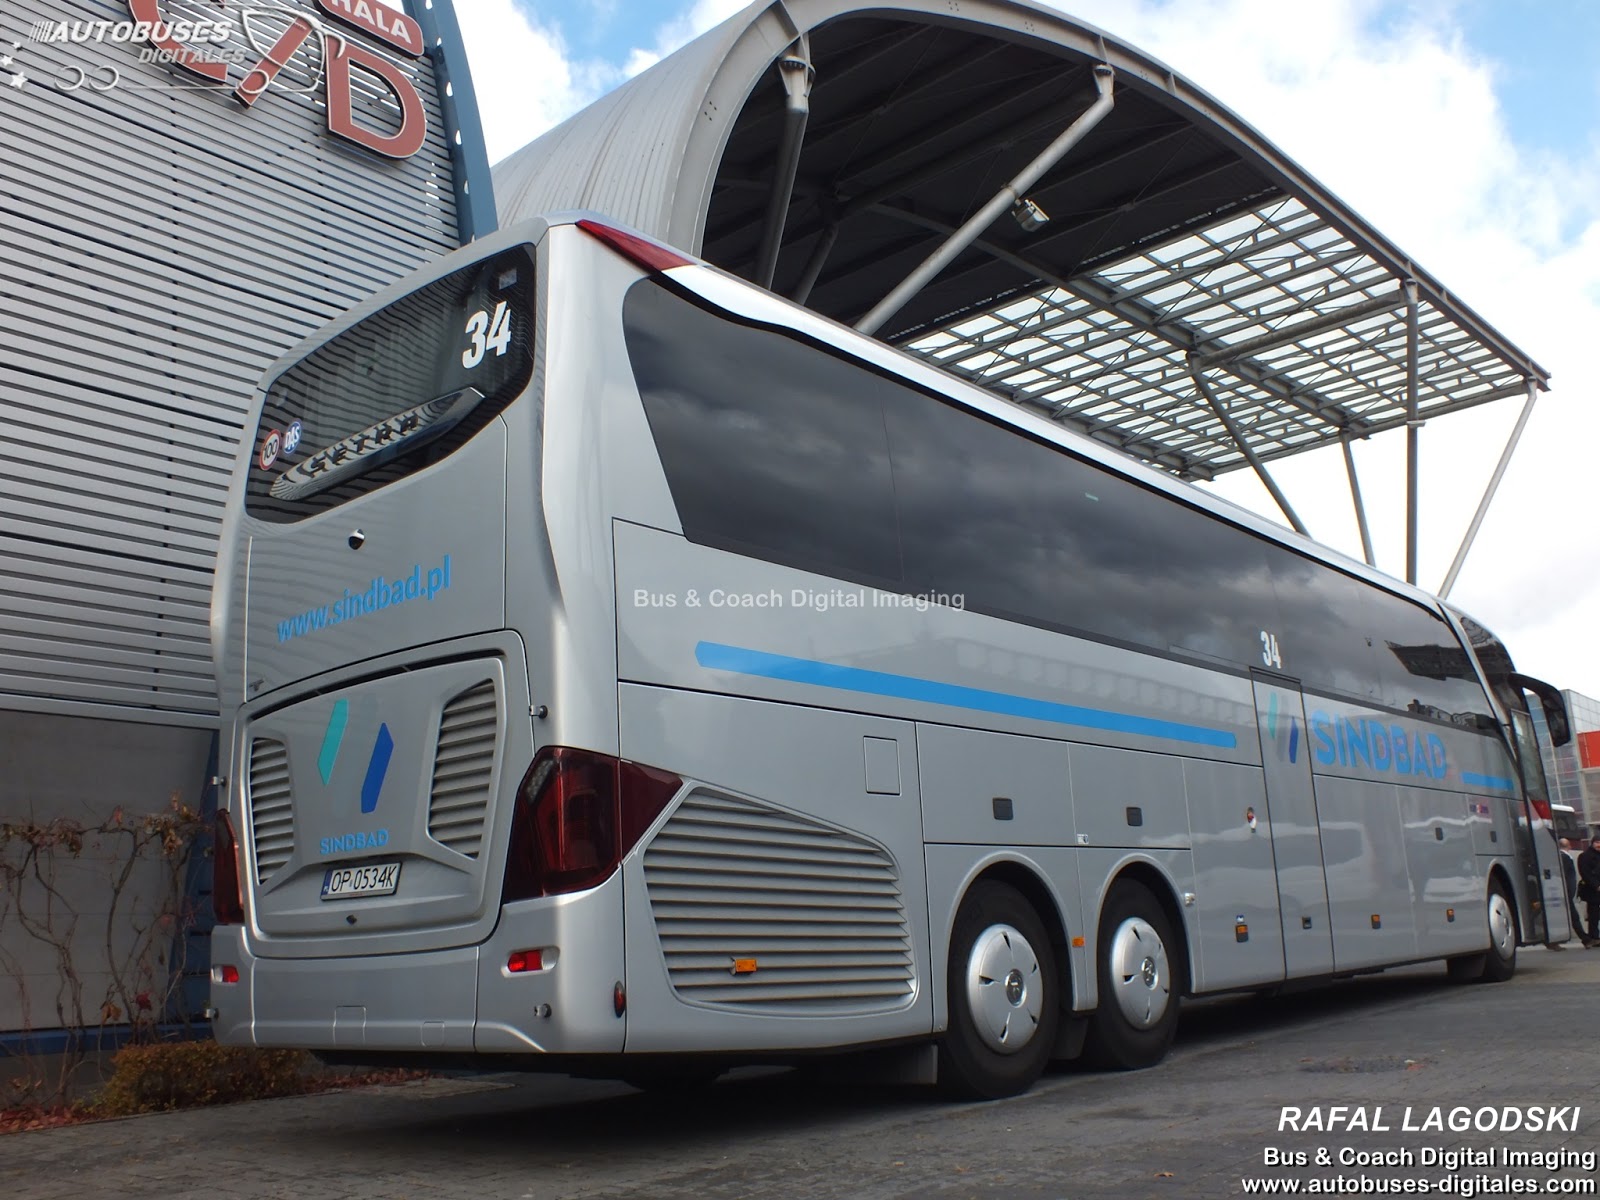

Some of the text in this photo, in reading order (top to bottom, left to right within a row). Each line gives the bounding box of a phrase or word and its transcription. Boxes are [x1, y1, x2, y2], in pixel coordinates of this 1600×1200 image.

[462, 300, 511, 369] 34
[263, 439, 278, 461] 100
[311, 410, 419, 471] SETRA
[276, 554, 450, 643] www.sindbad.pl
[1260, 630, 1282, 669] 34
[1311, 709, 1448, 780] SINDBAD
[320, 828, 389, 855] SINDBAD
[332, 865, 397, 892] OP 0534K
